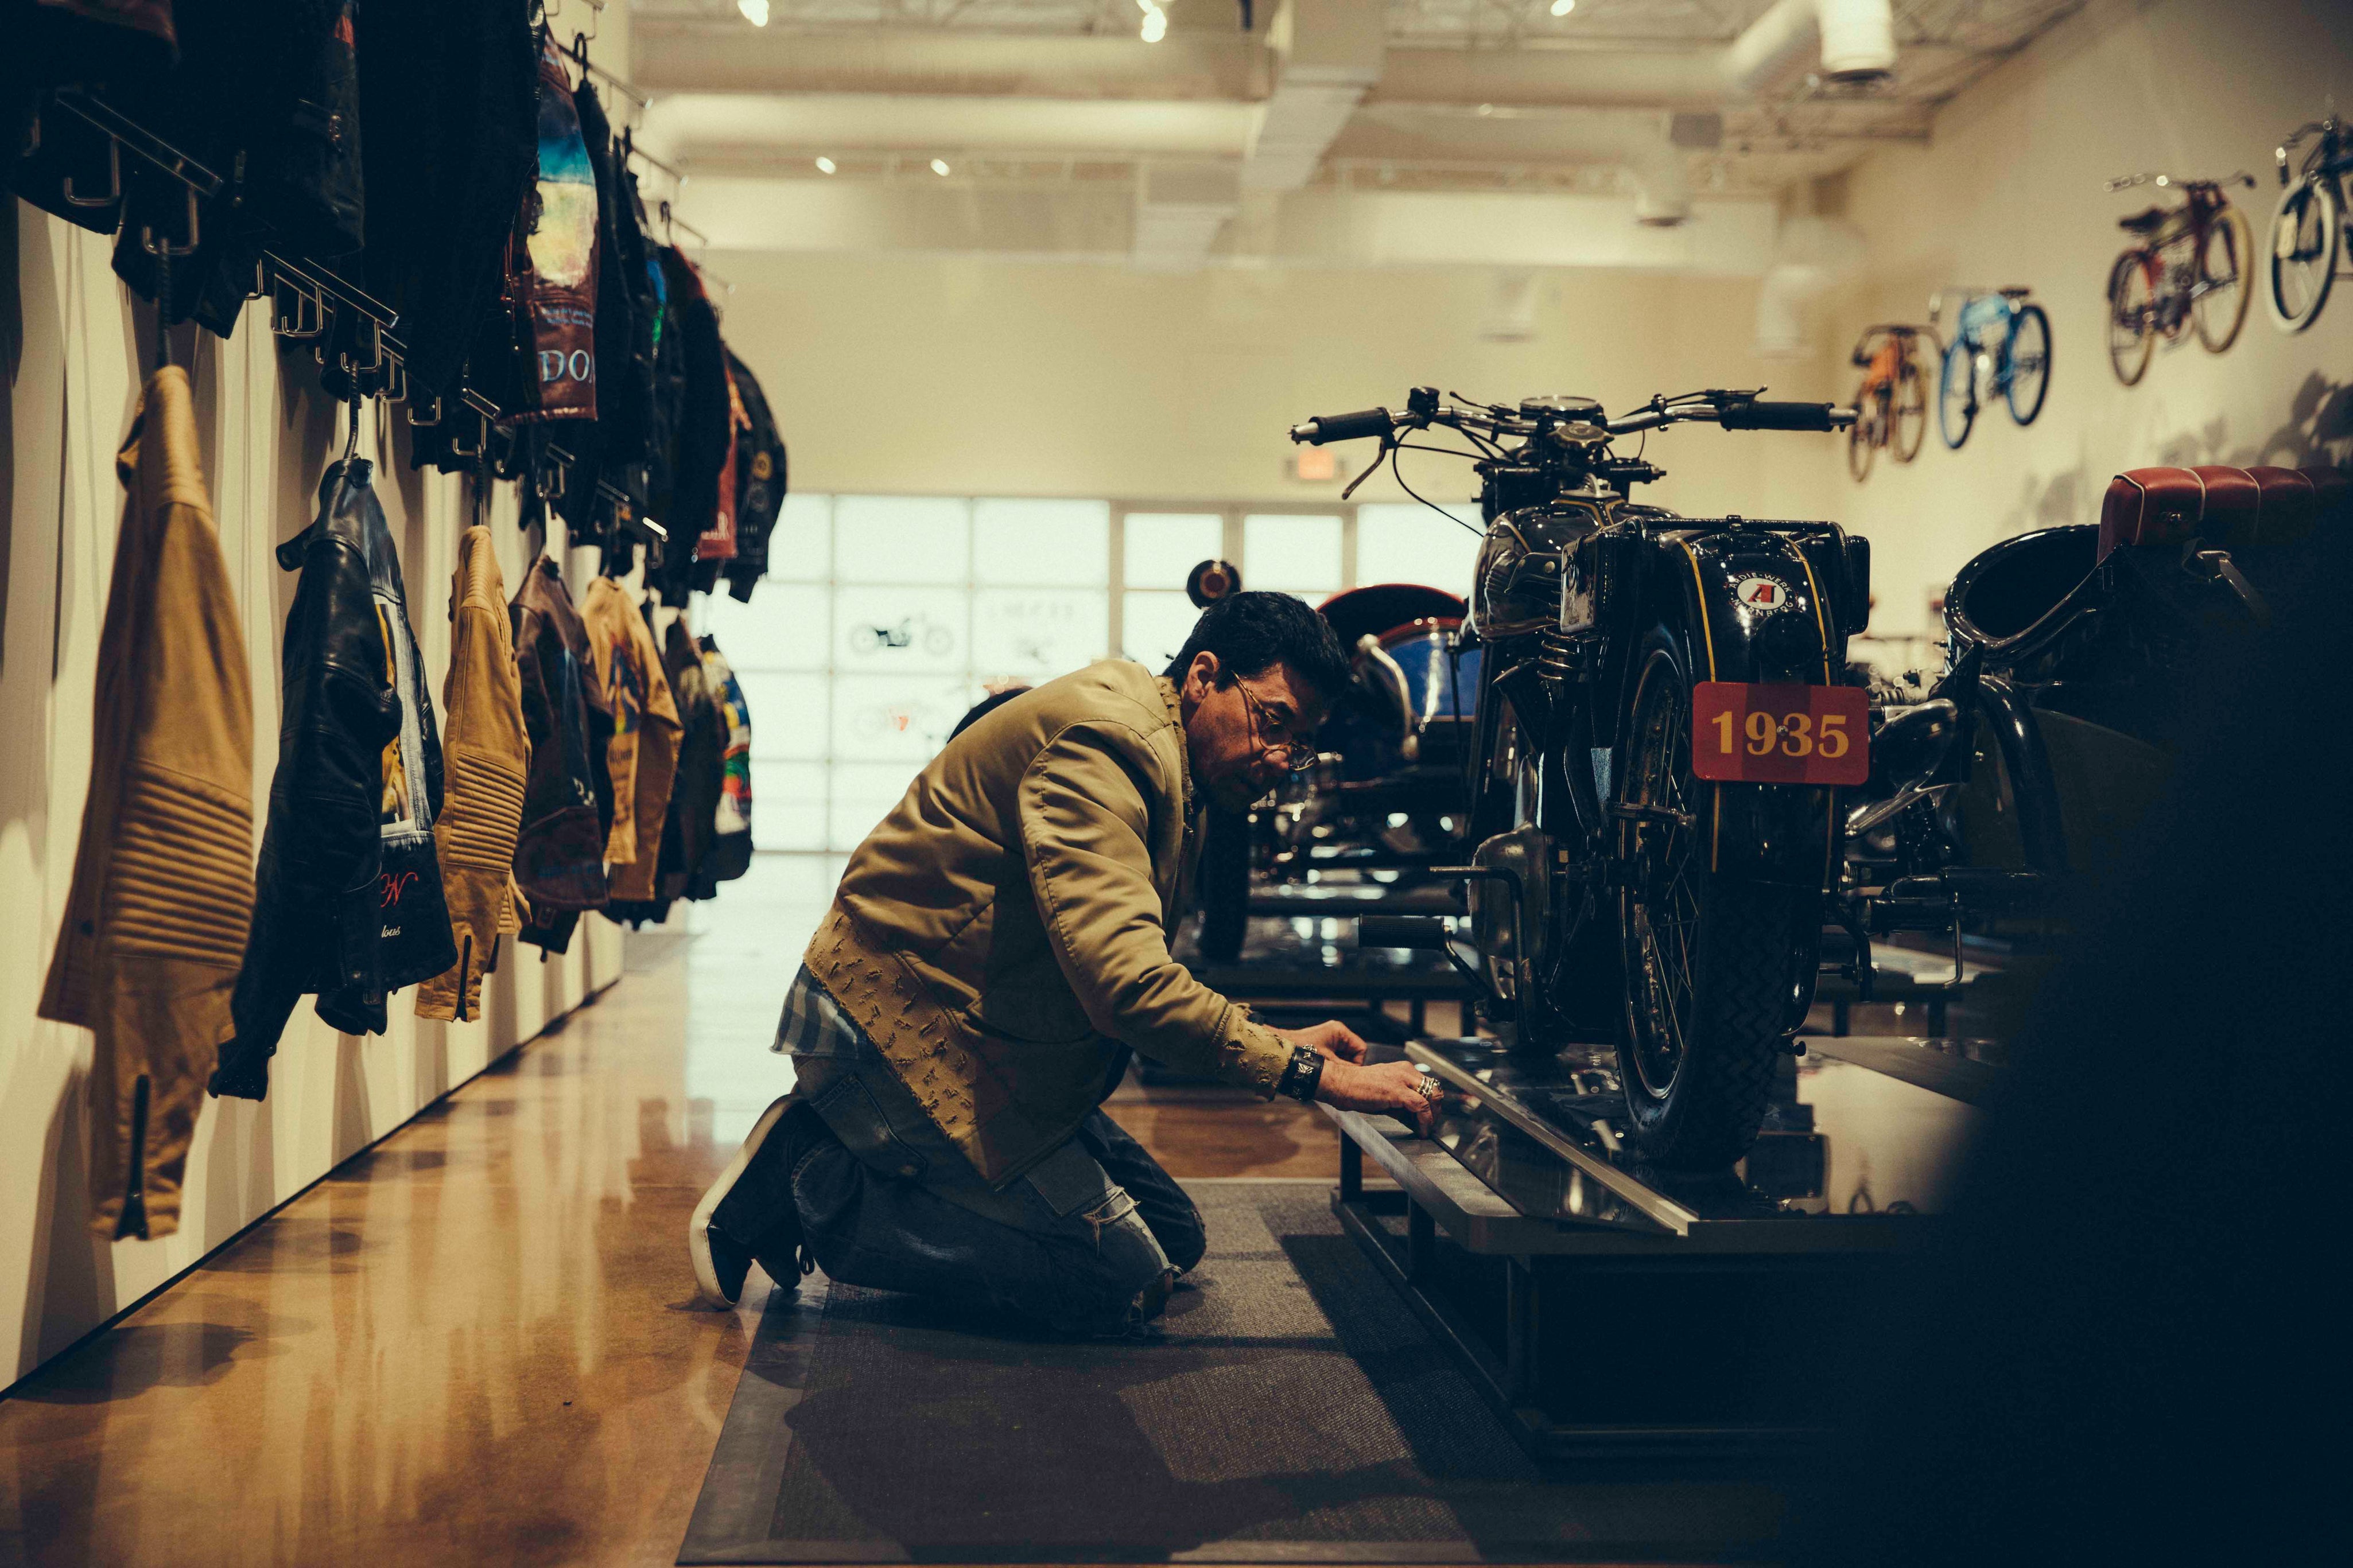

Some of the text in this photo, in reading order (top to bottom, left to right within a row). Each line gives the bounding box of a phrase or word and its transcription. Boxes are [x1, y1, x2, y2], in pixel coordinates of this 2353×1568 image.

[538, 349, 595, 384] DO
[1729, 573, 1793, 593] ARDIE-WERK
[1748, 584, 1777, 603] A
[1712, 711, 1849, 758] 1935
